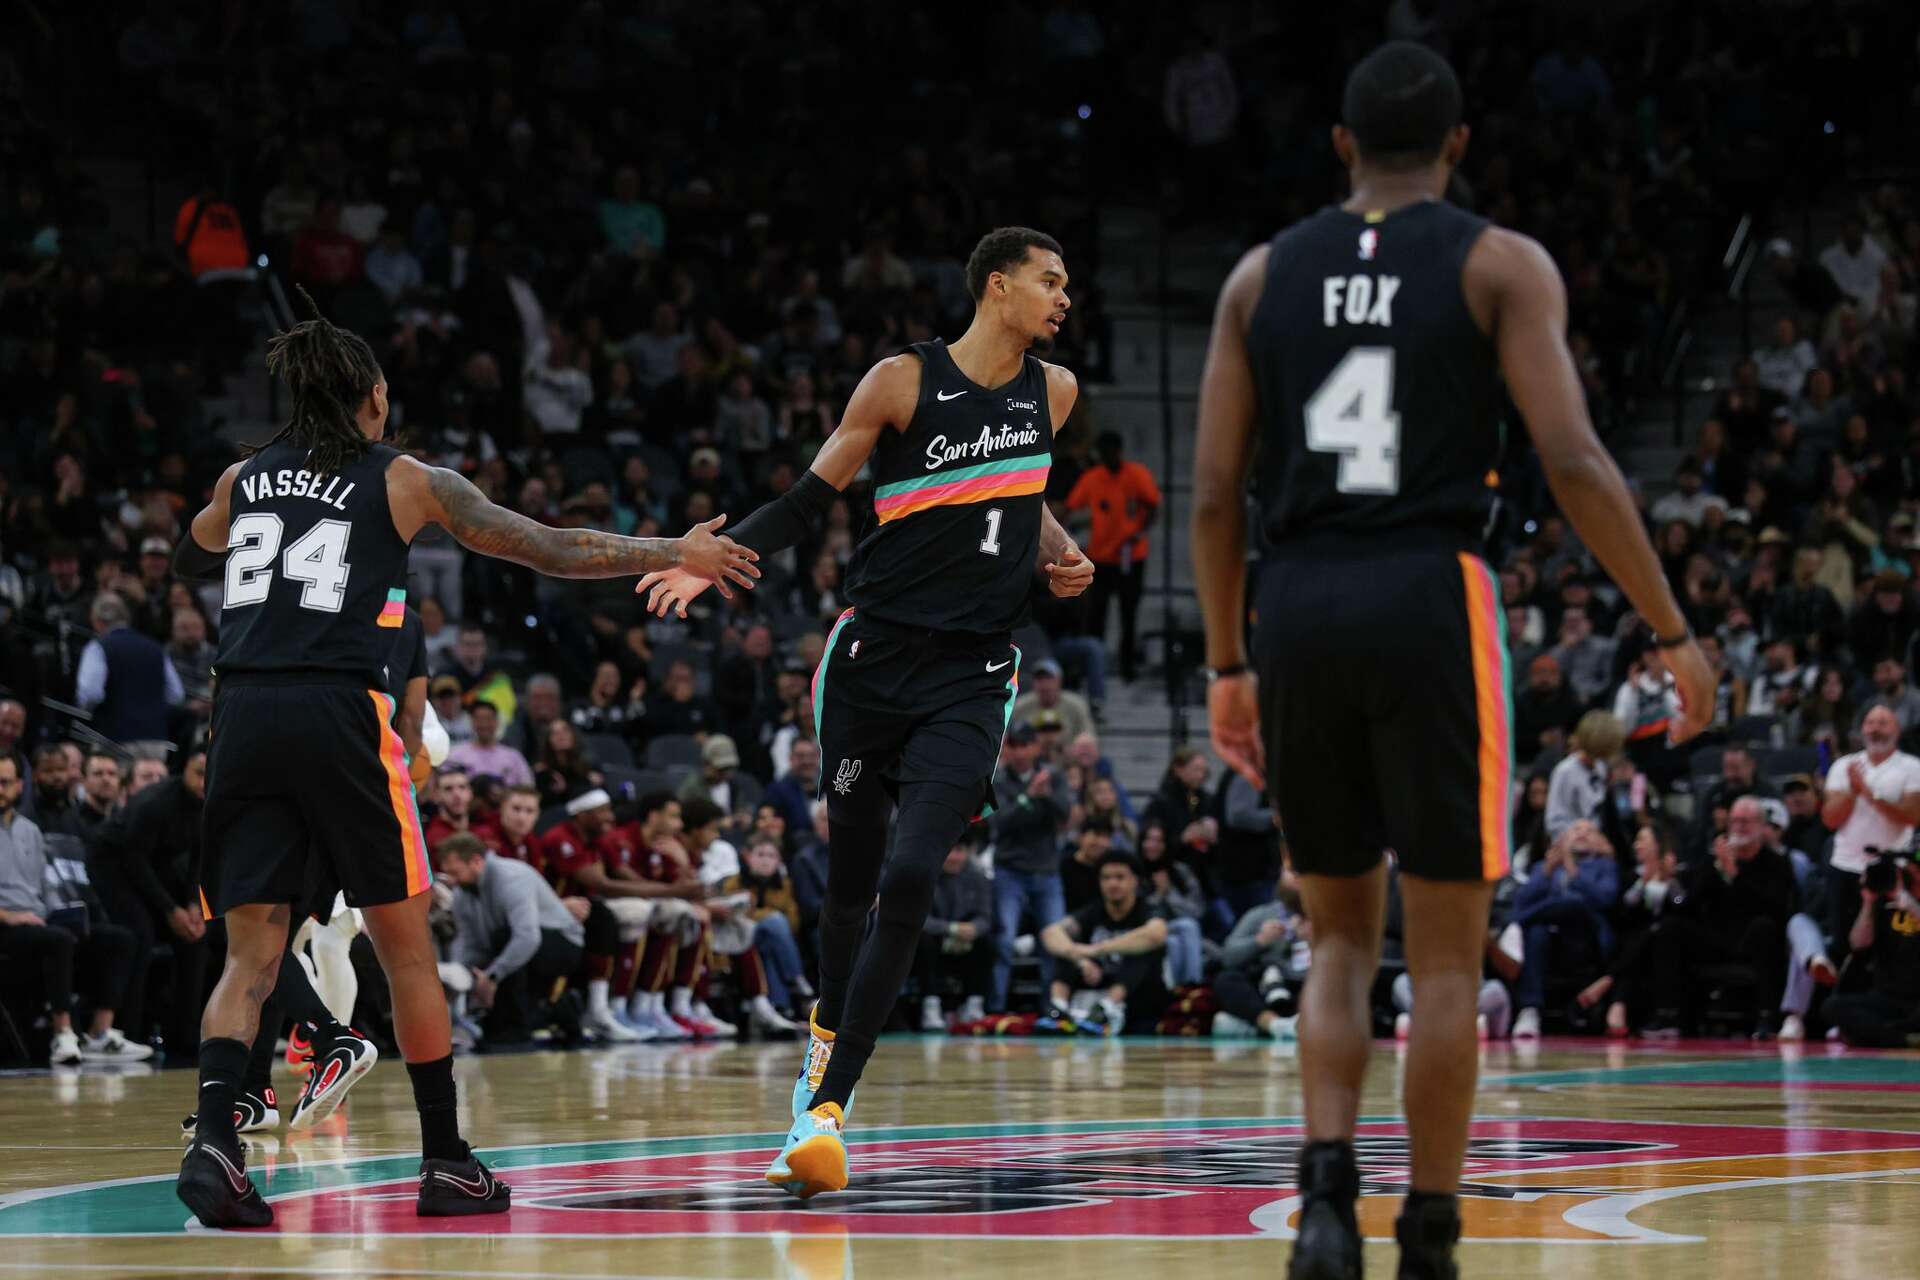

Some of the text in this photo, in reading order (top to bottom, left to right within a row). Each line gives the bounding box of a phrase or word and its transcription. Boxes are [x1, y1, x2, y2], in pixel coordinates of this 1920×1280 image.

[1323, 274, 1401, 327] FOX
[925, 422, 1039, 470] San Antonio
[1303, 346, 1401, 496] 4
[241, 469, 356, 511] VASSELL
[979, 508, 1003, 557] 1
[222, 512, 352, 613] 24
